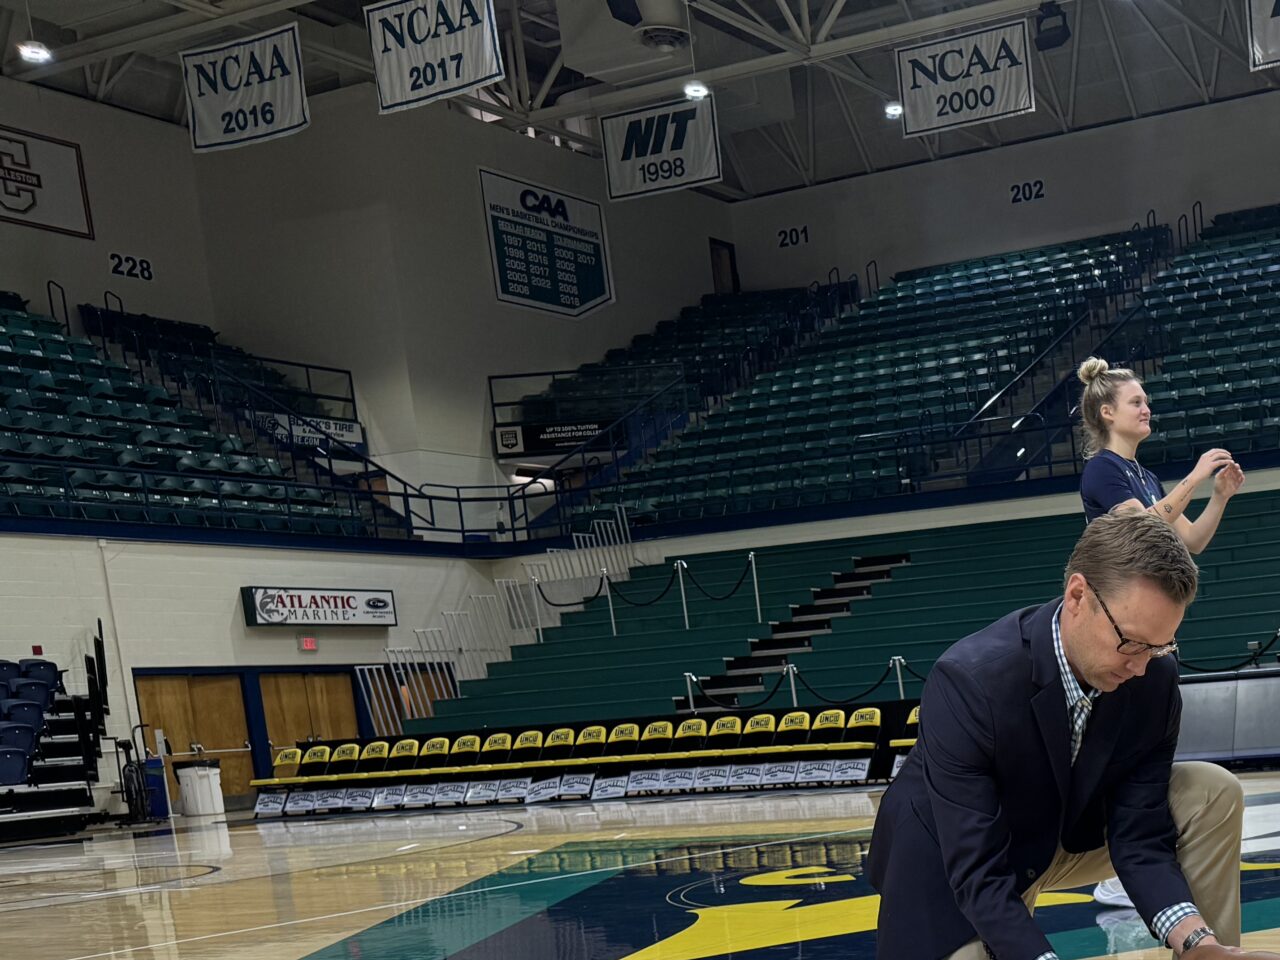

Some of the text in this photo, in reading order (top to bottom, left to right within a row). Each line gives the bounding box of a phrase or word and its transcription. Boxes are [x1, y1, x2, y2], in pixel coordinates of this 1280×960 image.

[379, 0, 482, 54] NCAA
[193, 44, 291, 98] NCAA
[409, 53, 463, 92] 2017
[908, 37, 1023, 90] NCAA
[936, 84, 995, 117] 2000
[221, 102, 275, 134] 2016
[620, 107, 697, 161] NIT
[639, 157, 685, 184] 1998
[1011, 180, 1045, 204] 202
[520, 189, 569, 223] CAA
[778, 225, 809, 248] 201
[109, 253, 153, 281] 228
[333, 421, 354, 432] TIRE
[275, 594, 358, 610] ATLANTIC
[288, 609, 350, 621] MARINE
[682, 721, 702, 732] UNCW
[716, 720, 736, 730] UNCW
[751, 717, 770, 727] UNCW
[784, 714, 805, 725] UNCW
[819, 712, 840, 723] UNCW
[854, 711, 875, 722] UNCW
[648, 724, 668, 734] UNCW
